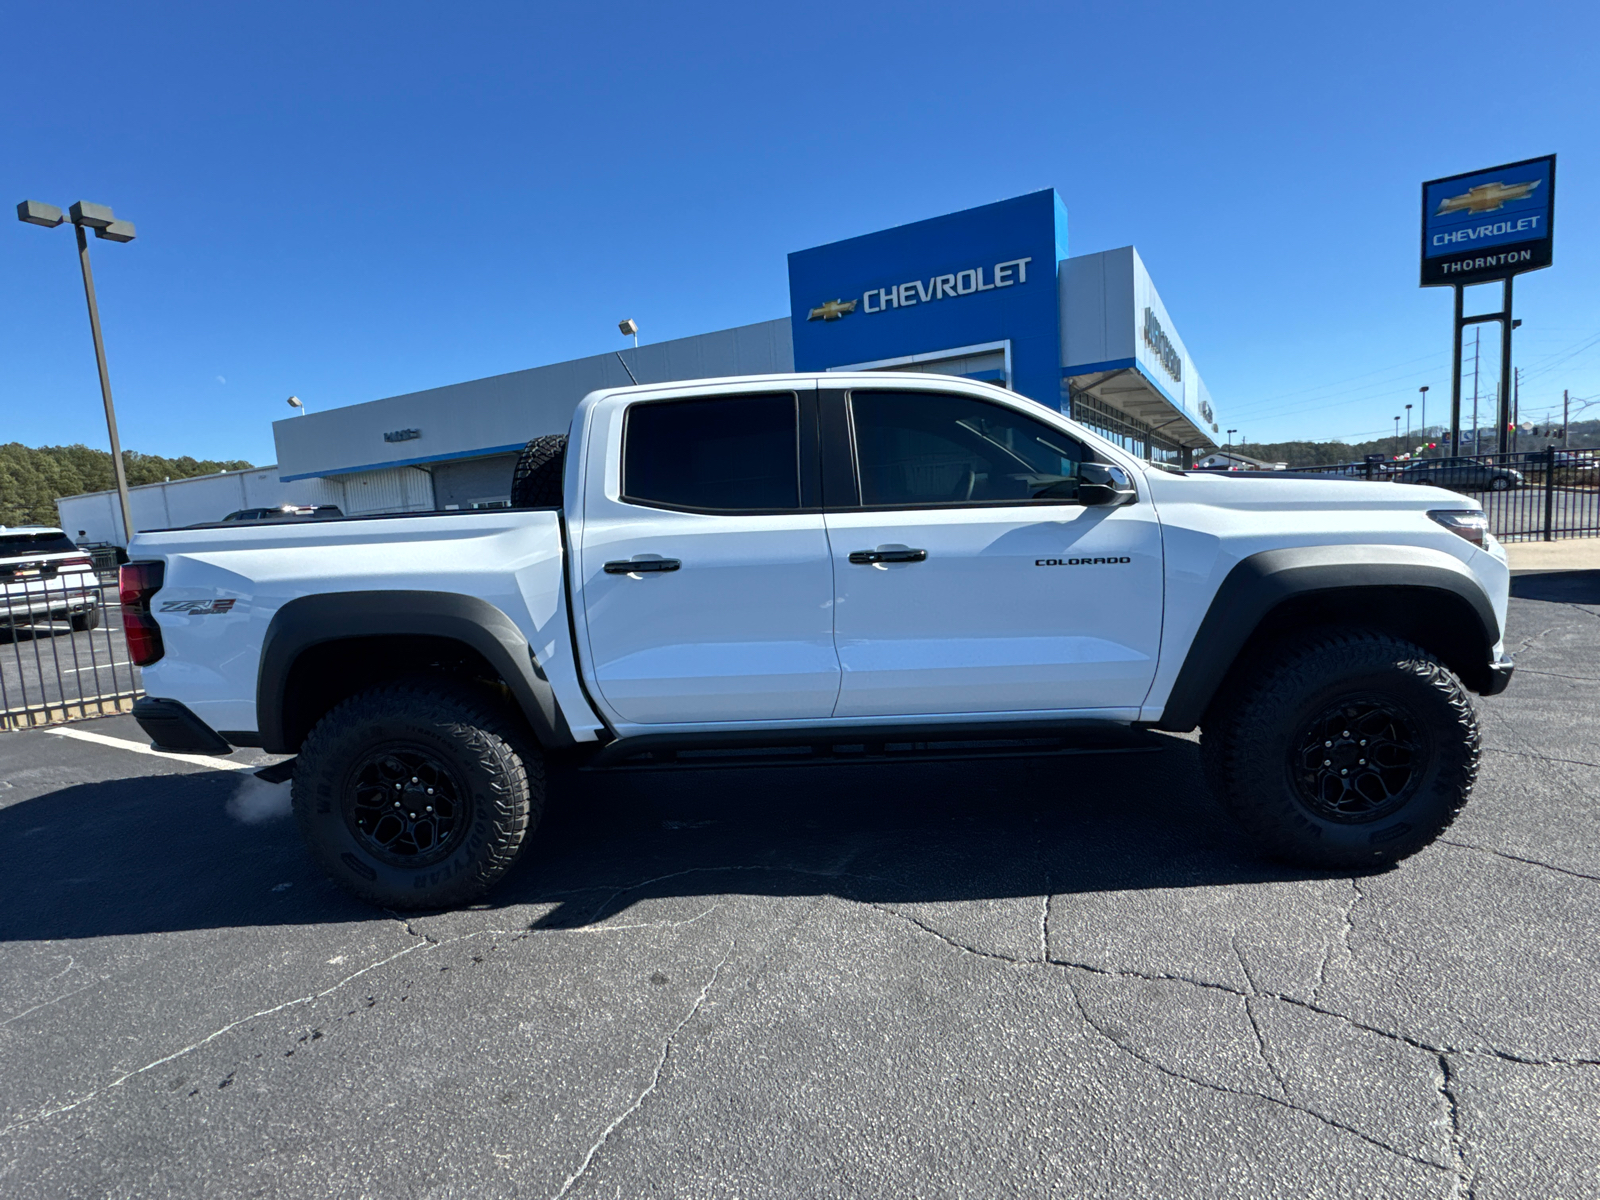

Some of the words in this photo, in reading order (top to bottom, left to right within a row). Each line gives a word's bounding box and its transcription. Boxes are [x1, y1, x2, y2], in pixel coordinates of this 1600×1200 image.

[1432, 215, 1541, 246] CHEVROLET
[1441, 249, 1532, 274] THORNTON
[863, 256, 1032, 314] CHEVROLET
[1035, 556, 1131, 567] COLORADO
[159, 598, 237, 613] ZR2
